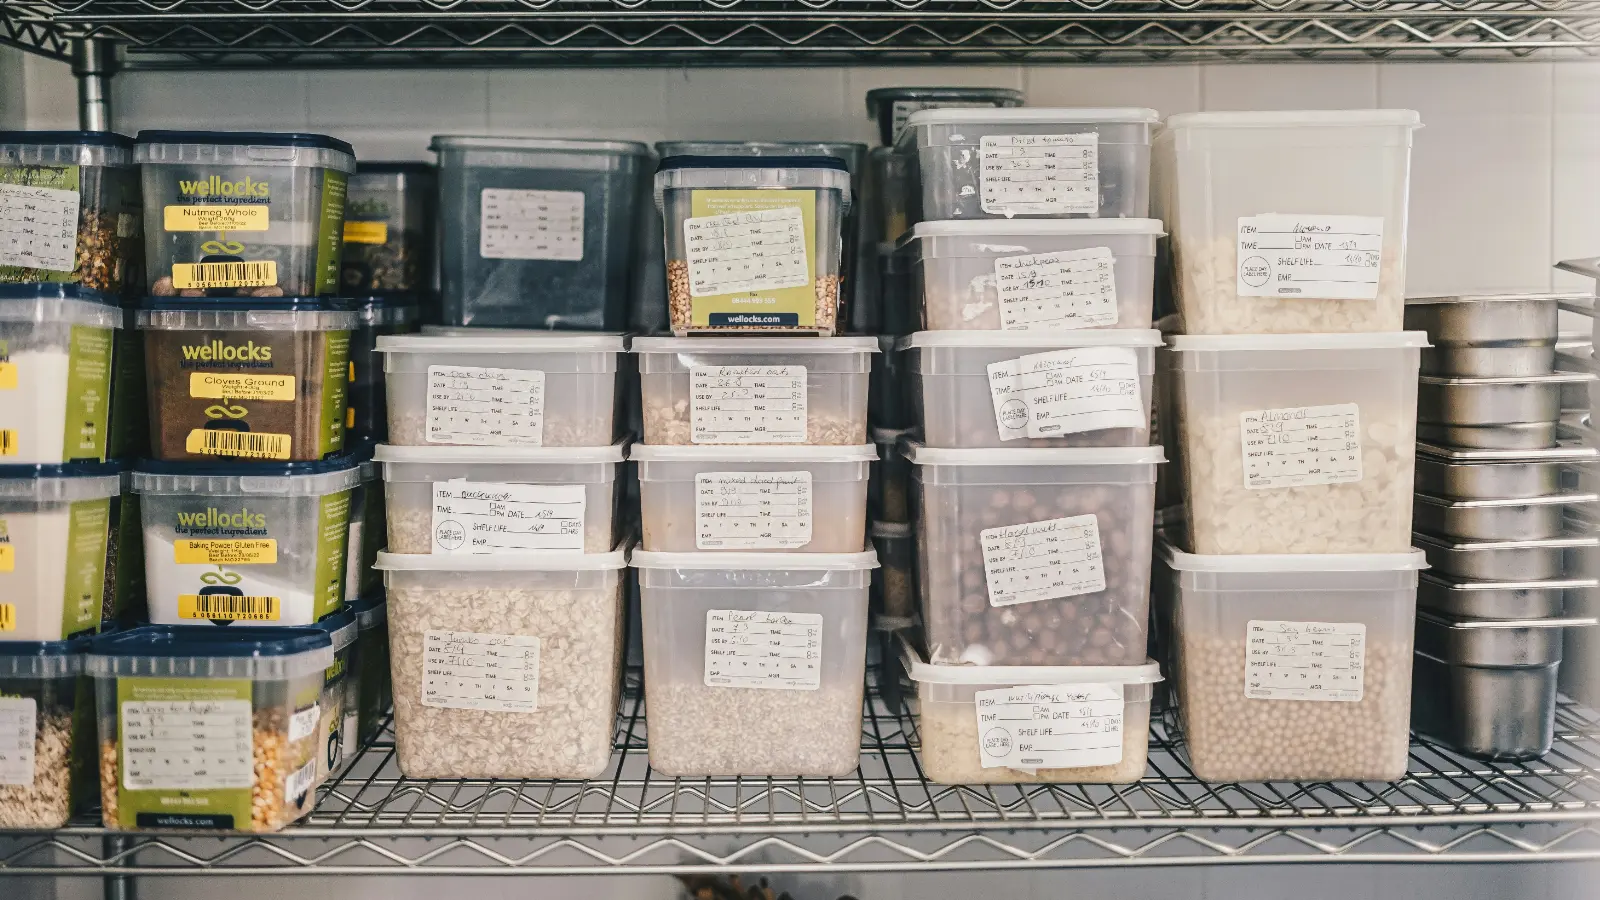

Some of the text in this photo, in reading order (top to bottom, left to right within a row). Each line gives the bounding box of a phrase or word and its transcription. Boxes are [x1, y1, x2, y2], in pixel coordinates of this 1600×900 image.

[179, 175, 269, 196] wellocks
[192, 196, 221, 205] perfect
[224, 196, 271, 205] ingredient
[184, 209, 221, 217] Nutmeg
[182, 340, 272, 360] wellocks
[196, 362, 226, 370] perfect
[228, 361, 273, 370] ingredient
[993, 372, 1008, 380] ITEM
[1066, 376, 1083, 384] DATE
[245, 378, 284, 386] Ground
[995, 386, 1010, 395] TIME
[1034, 393, 1067, 404] SHELF LIFE
[177, 507, 266, 528] wellocks
[175, 525, 267, 537] the perfect ingredient
[473, 523, 492, 531] SHELF
[190, 542, 209, 550] Baking
